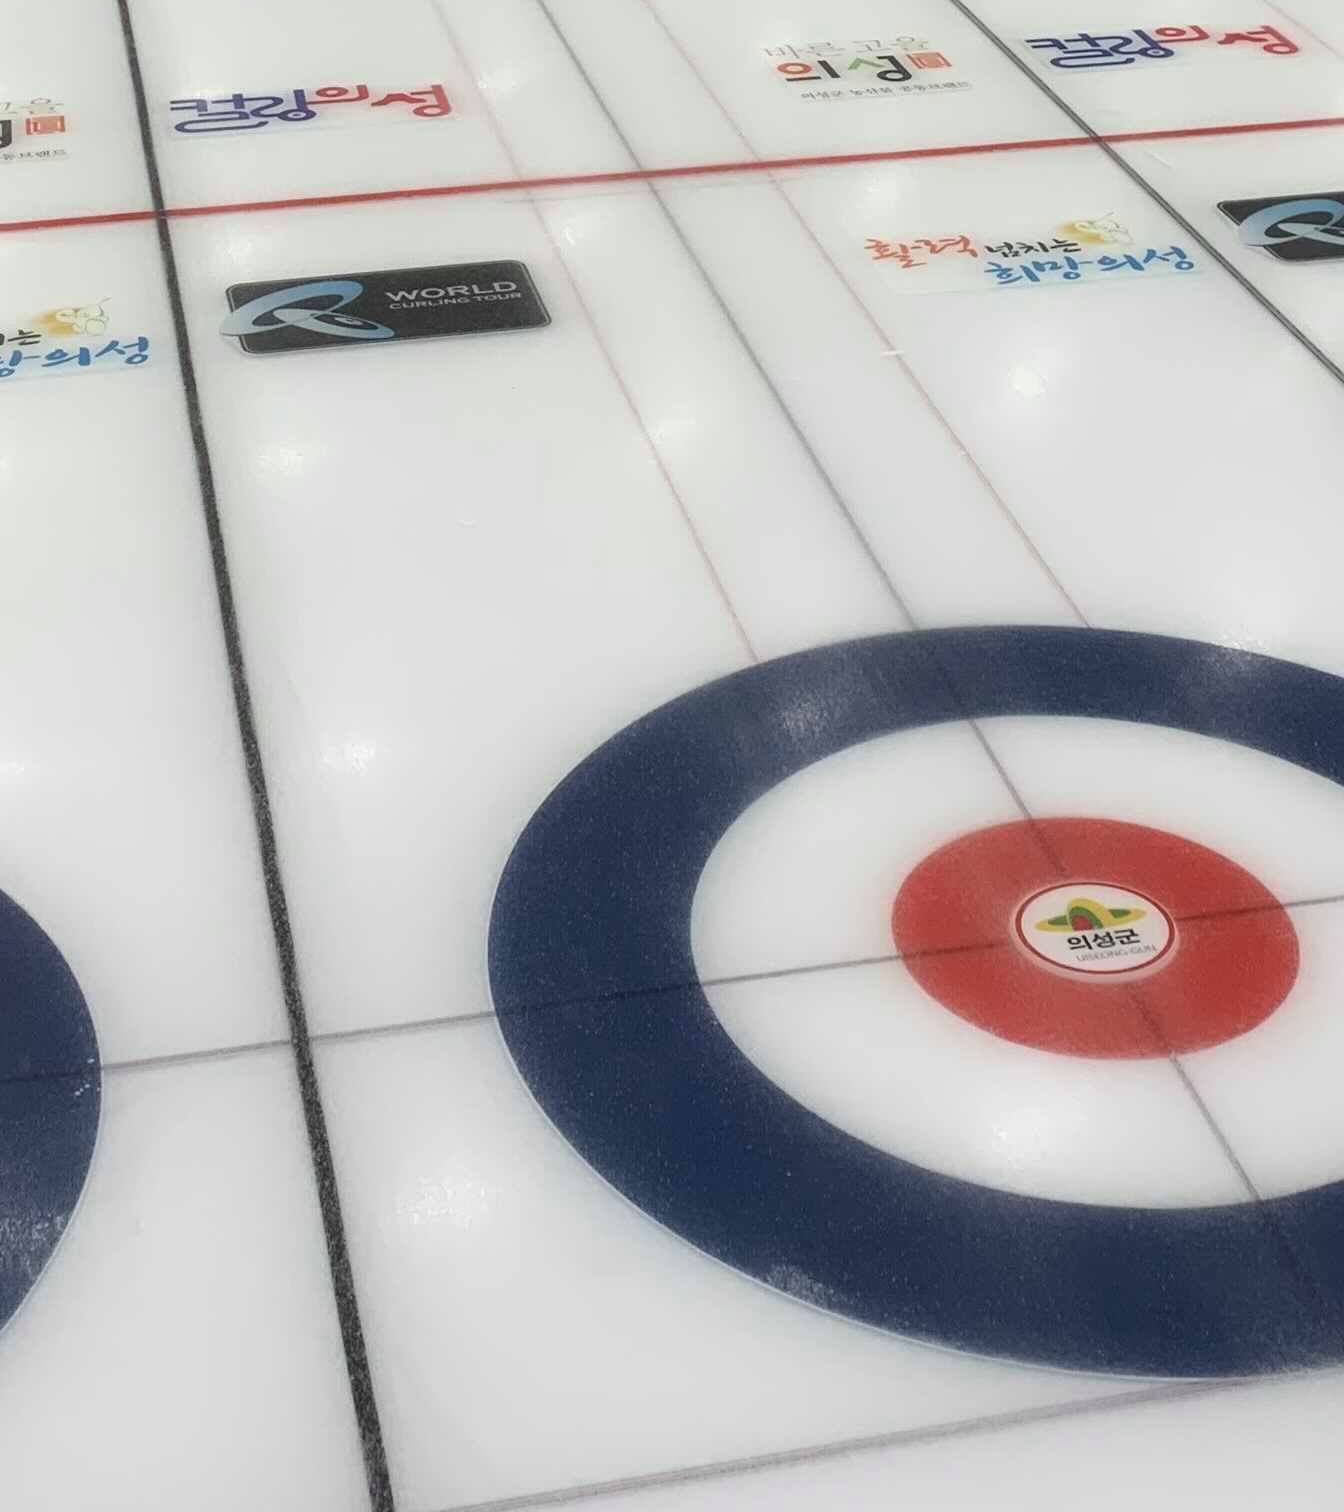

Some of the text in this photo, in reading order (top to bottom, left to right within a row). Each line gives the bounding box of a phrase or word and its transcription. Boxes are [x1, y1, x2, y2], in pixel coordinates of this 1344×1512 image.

[777, 54, 913, 83] 의성
[385, 281, 518, 302] WORLD
[389, 292, 522, 310] CURLING TOUR
[1067, 928, 1141, 951] 의성군
